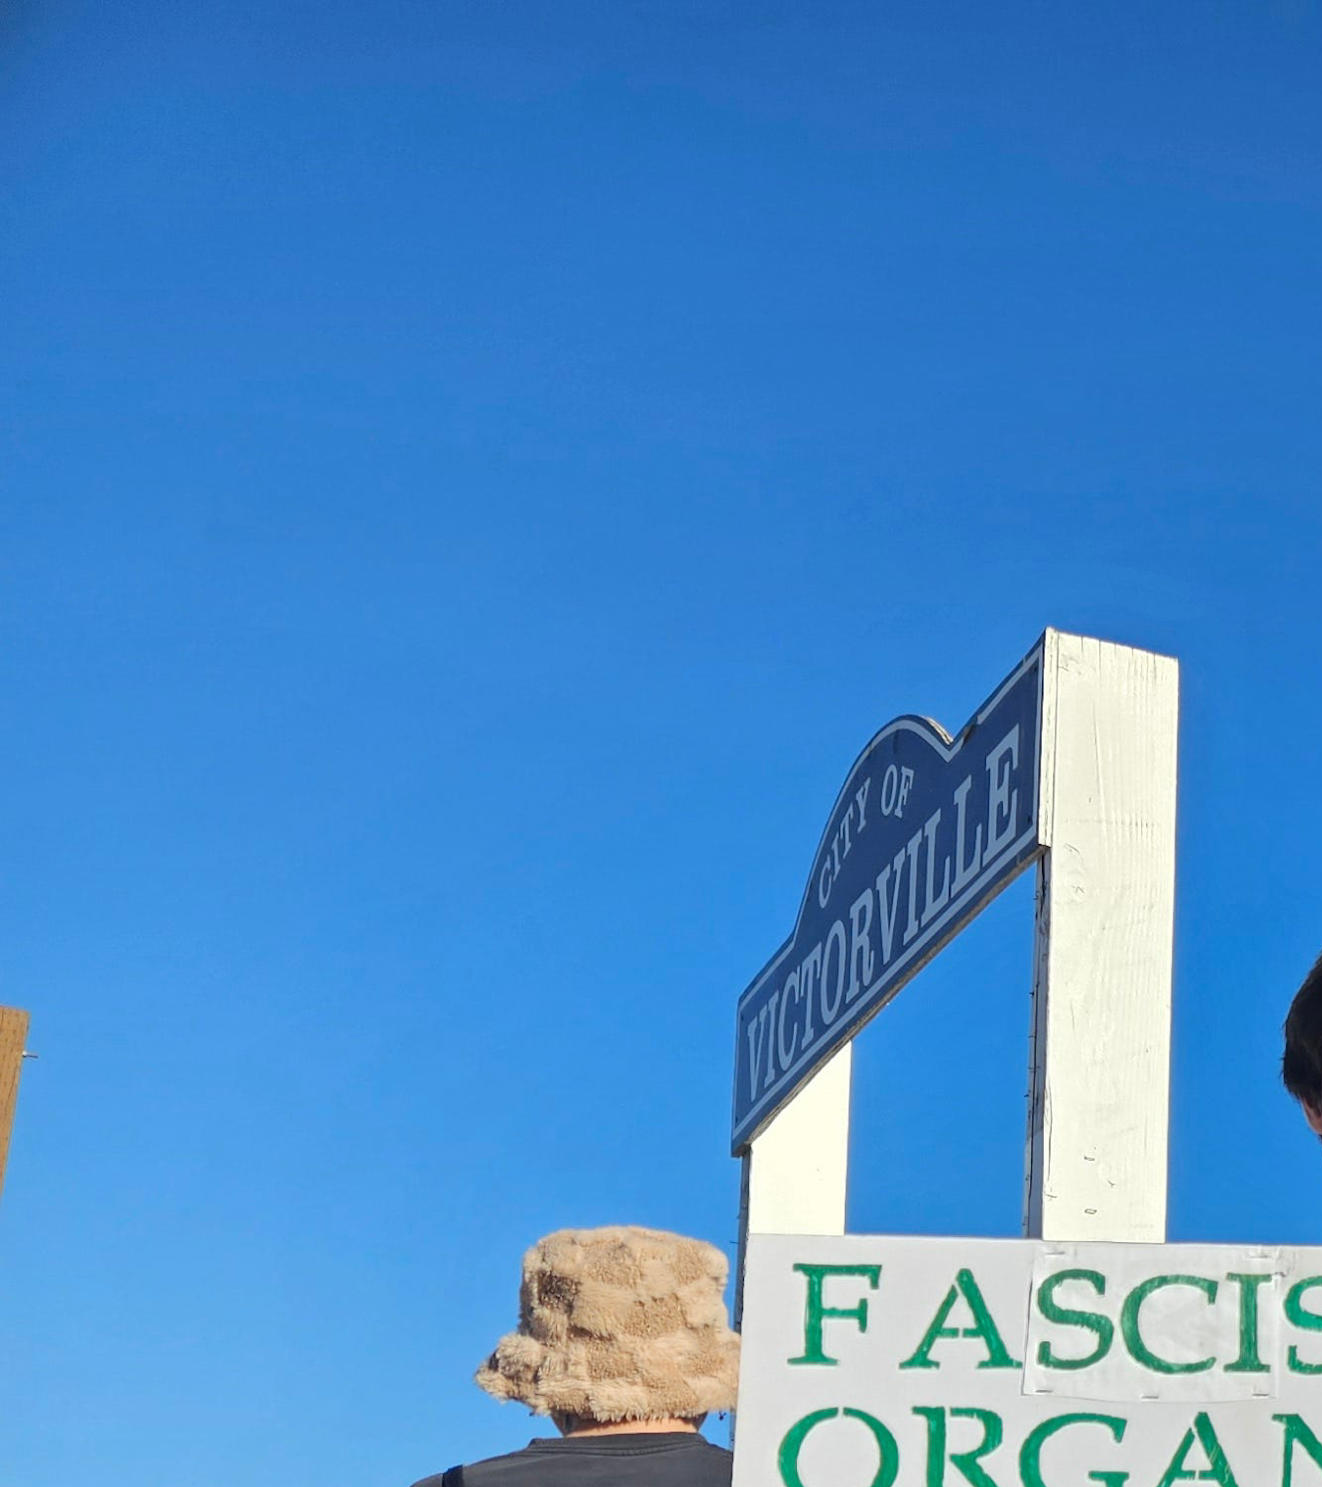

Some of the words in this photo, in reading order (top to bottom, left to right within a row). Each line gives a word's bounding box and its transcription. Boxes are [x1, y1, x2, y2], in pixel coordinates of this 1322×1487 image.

[747, 723, 1020, 1102] VICTORVILLE
[818, 773, 870, 908] CITY
[881, 763, 914, 819] OF
